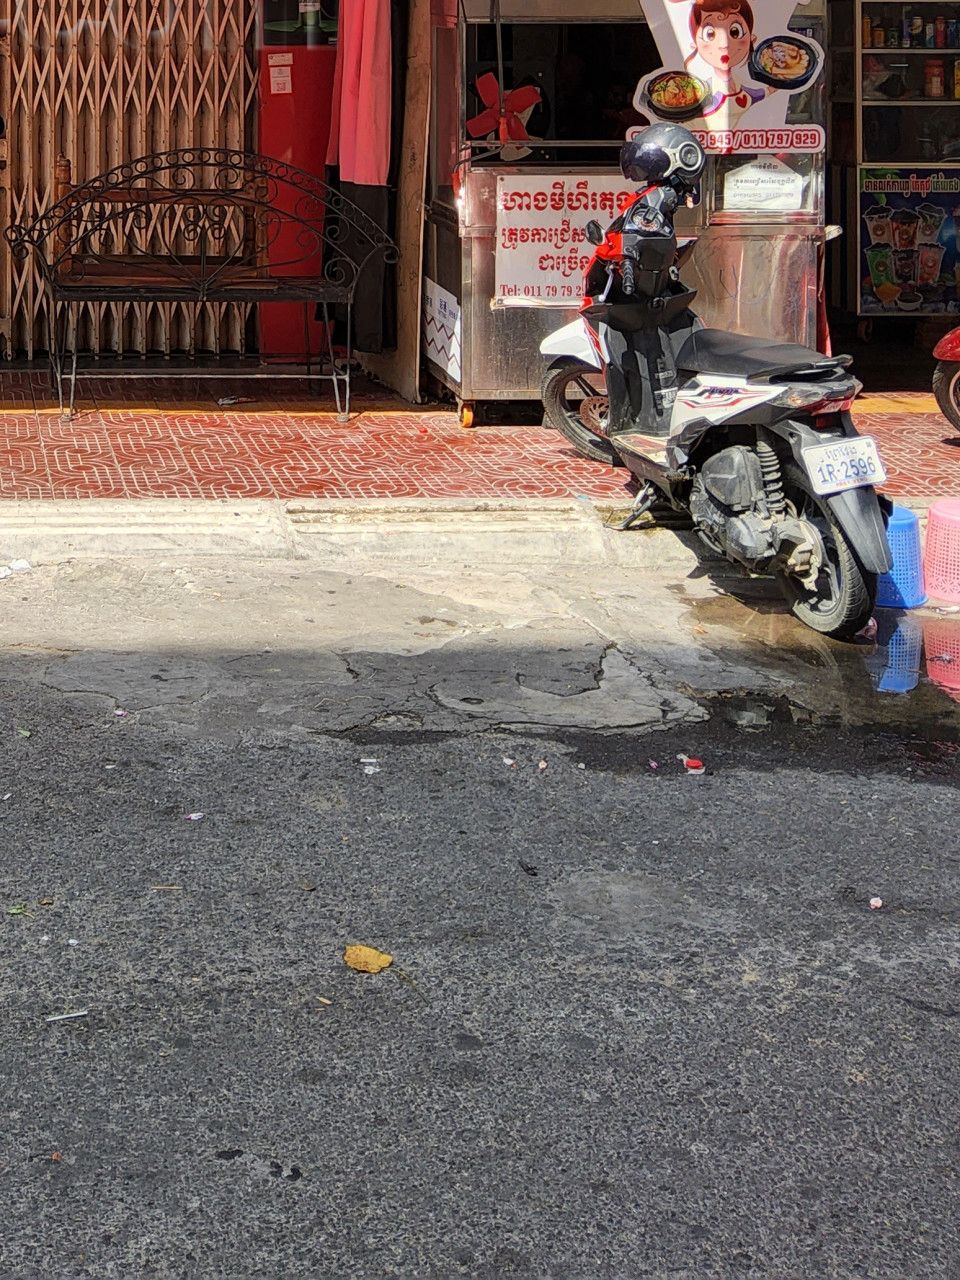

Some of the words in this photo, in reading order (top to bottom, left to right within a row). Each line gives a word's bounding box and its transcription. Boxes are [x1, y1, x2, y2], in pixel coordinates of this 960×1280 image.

[709, 132, 732, 145] 945
[743, 132, 766, 145] 011
[768, 132, 790, 145] 797
[795, 132, 817, 145] 929
[500, 285, 521, 297] Tel:
[524, 285, 541, 297] 011
[545, 285, 558, 297] 79
[561, 285, 573, 297] 79
